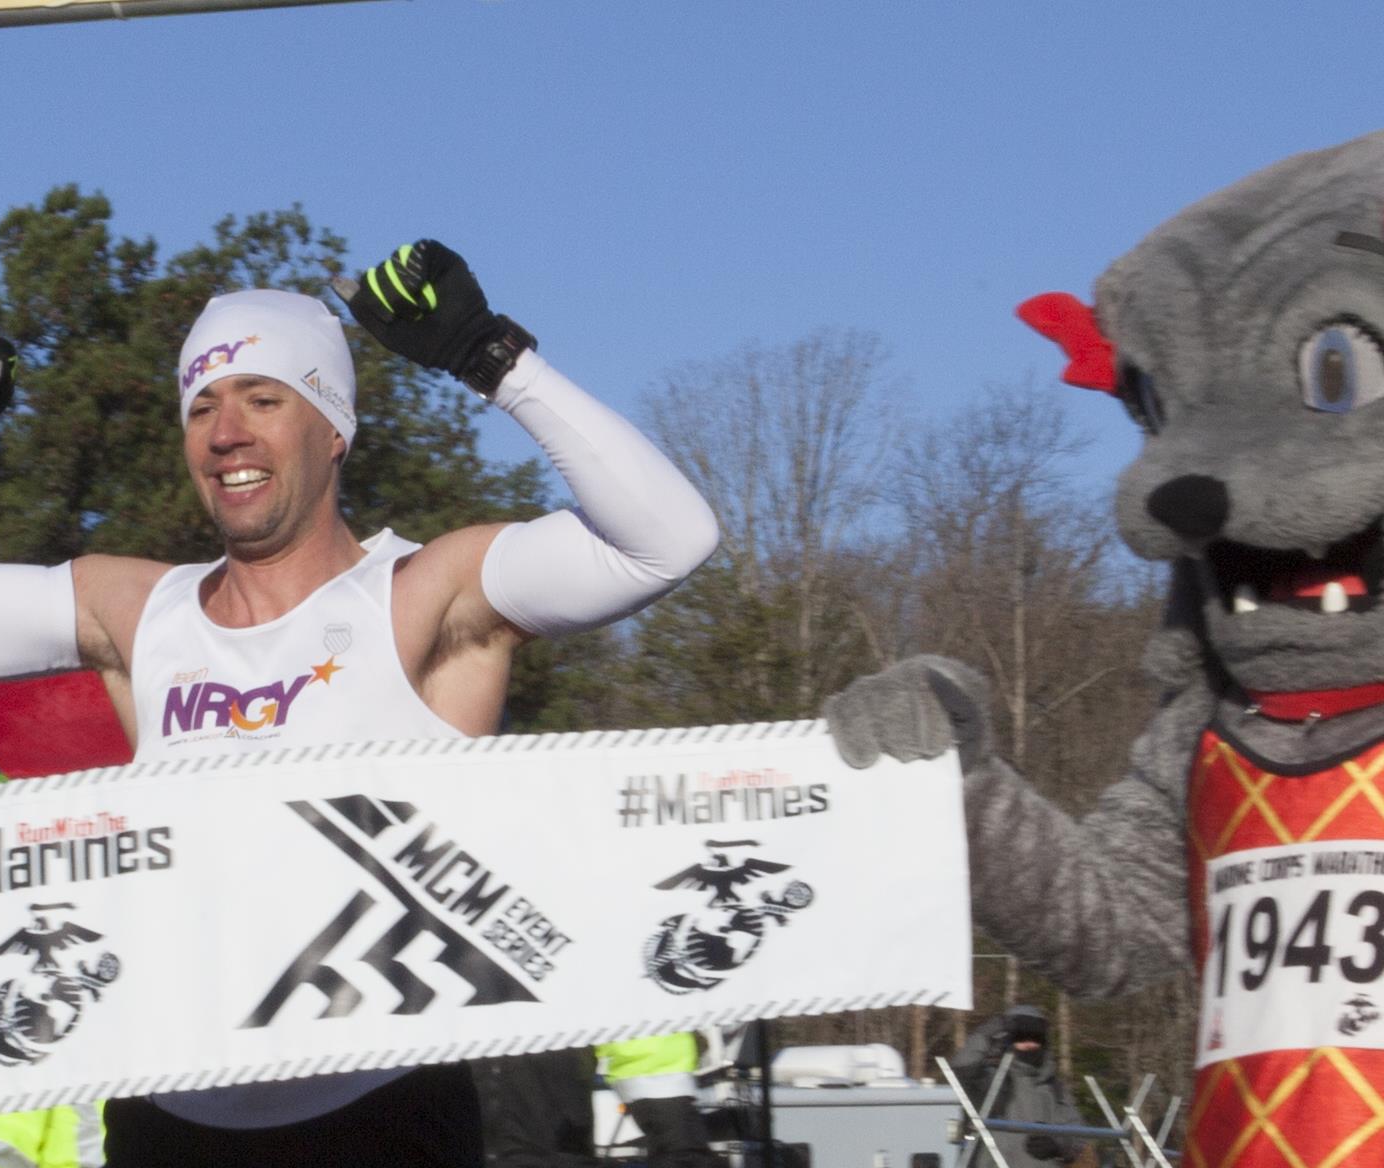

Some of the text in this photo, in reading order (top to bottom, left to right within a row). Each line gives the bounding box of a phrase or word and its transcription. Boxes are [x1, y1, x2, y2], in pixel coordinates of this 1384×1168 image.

[162, 674, 314, 738] NRGY
[617, 773, 831, 828] #Marines
[391, 821, 512, 928] MCM
[479, 917, 559, 983] SERIES
[503, 896, 575, 957] EVENT
